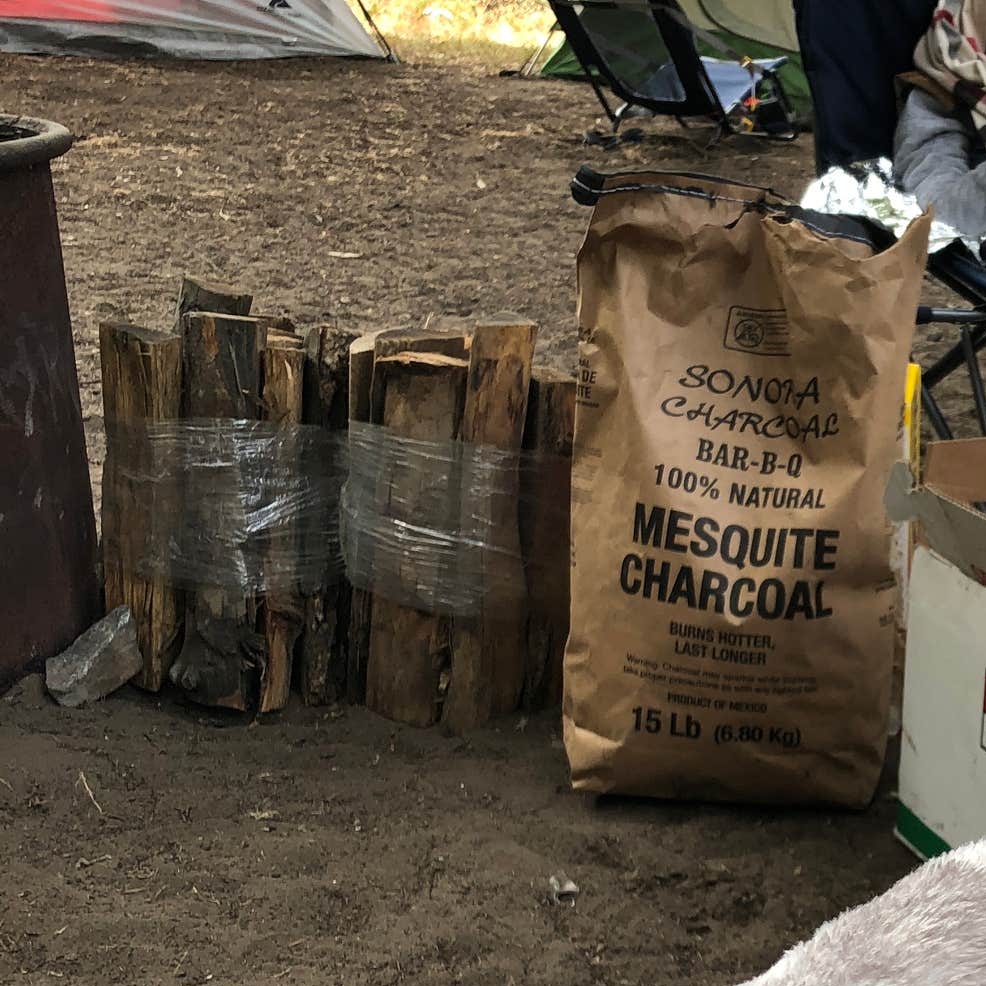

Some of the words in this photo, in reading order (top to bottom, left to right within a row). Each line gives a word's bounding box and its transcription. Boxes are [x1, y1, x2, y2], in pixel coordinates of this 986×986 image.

[661, 396, 839, 446] CHARCOAL
[696, 438, 803, 478] BAR-B-Q
[654, 464, 720, 500] 100%
[728, 482, 826, 509] NATURAL
[632, 502, 840, 571] MESQUITE
[619, 553, 833, 621] CHARCOAL
[669, 620, 714, 643] BURNS
[675, 640, 708, 658] LAST
[712, 647, 767, 665] LONGER
[667, 691, 712, 709] PRODUCT
[714, 700, 726, 711] OF
[729, 701, 768, 714] MEXICO
[632, 706, 662, 734] 15
[670, 712, 702, 739] Lb
[714, 723, 763, 745] (6.80
[768, 725, 802, 748] Kg)
